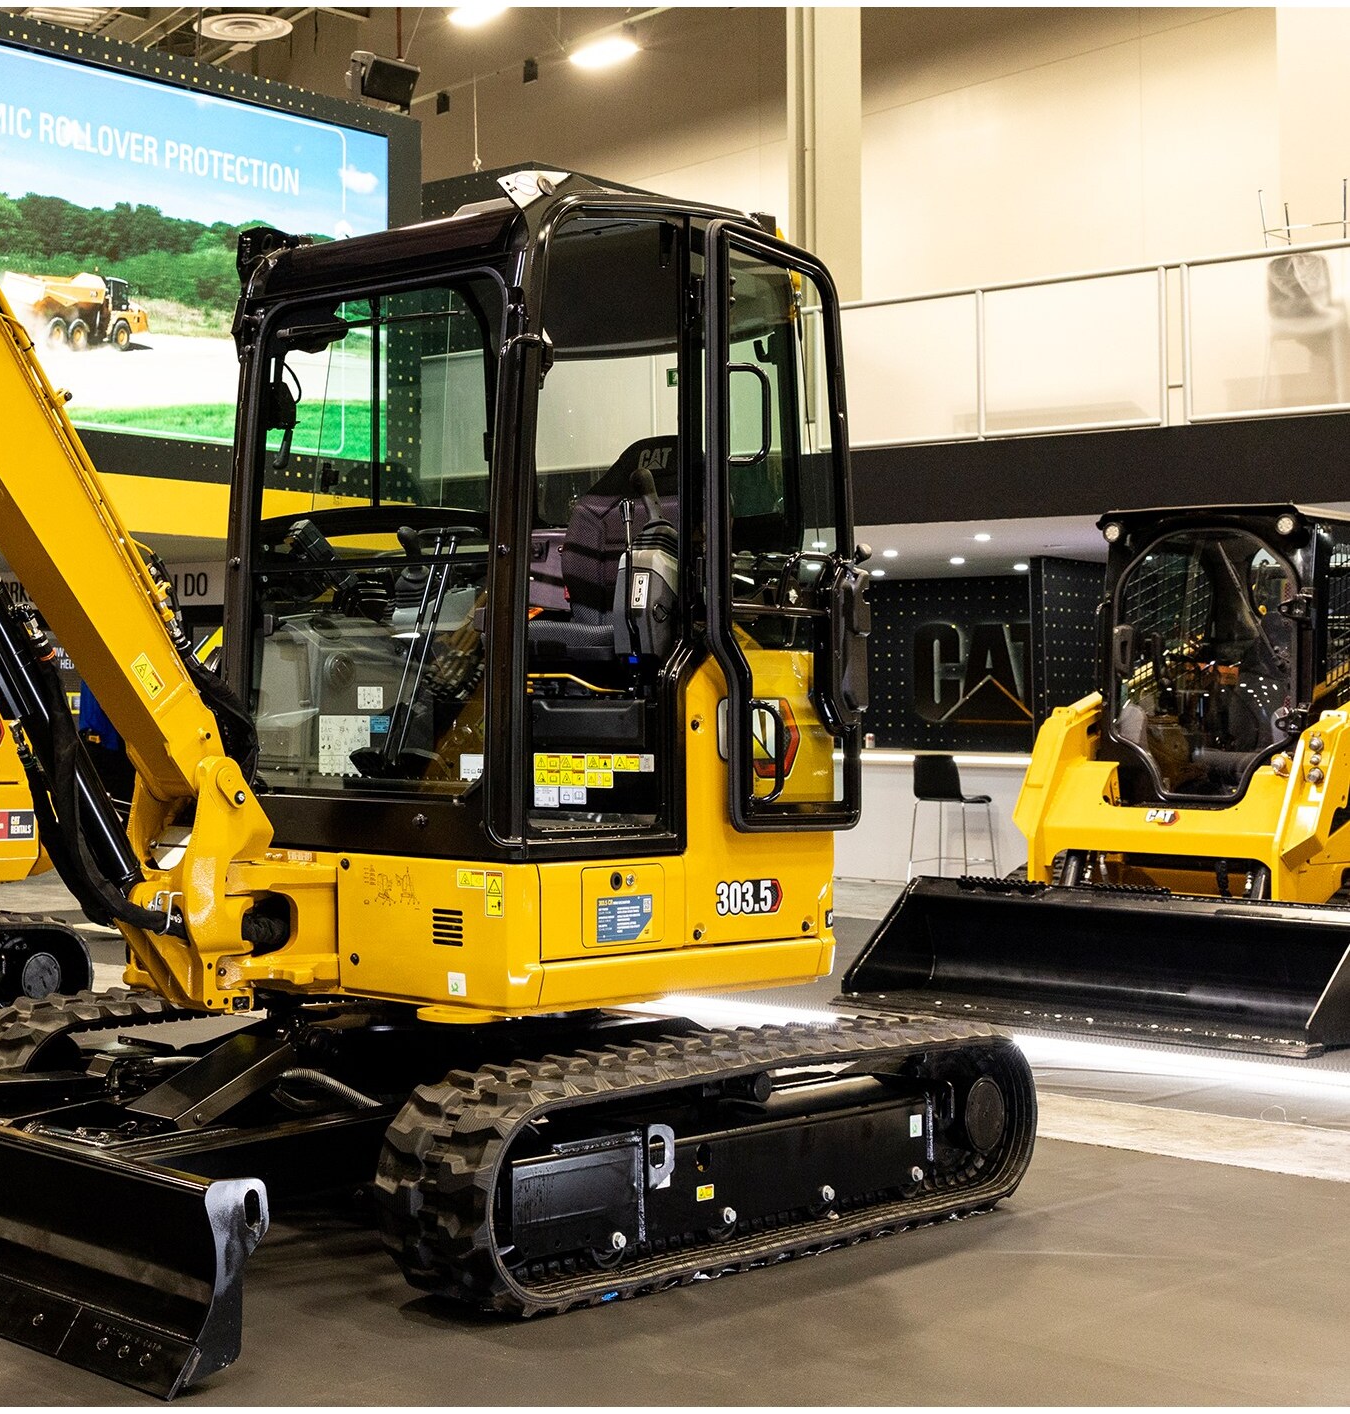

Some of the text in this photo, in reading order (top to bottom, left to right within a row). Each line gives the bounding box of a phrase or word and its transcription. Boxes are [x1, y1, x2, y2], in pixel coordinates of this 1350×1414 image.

[39, 112, 158, 166] ROLLOVER
[164, 140, 300, 196] PROTECTION
[637, 447, 673, 469] CAT
[184, 572, 208, 597] DO
[10, 815, 21, 825] CAT
[1145, 809, 1175, 823] CAT
[10, 824, 32, 834] RENTALS
[716, 880, 772, 915] 303.5
